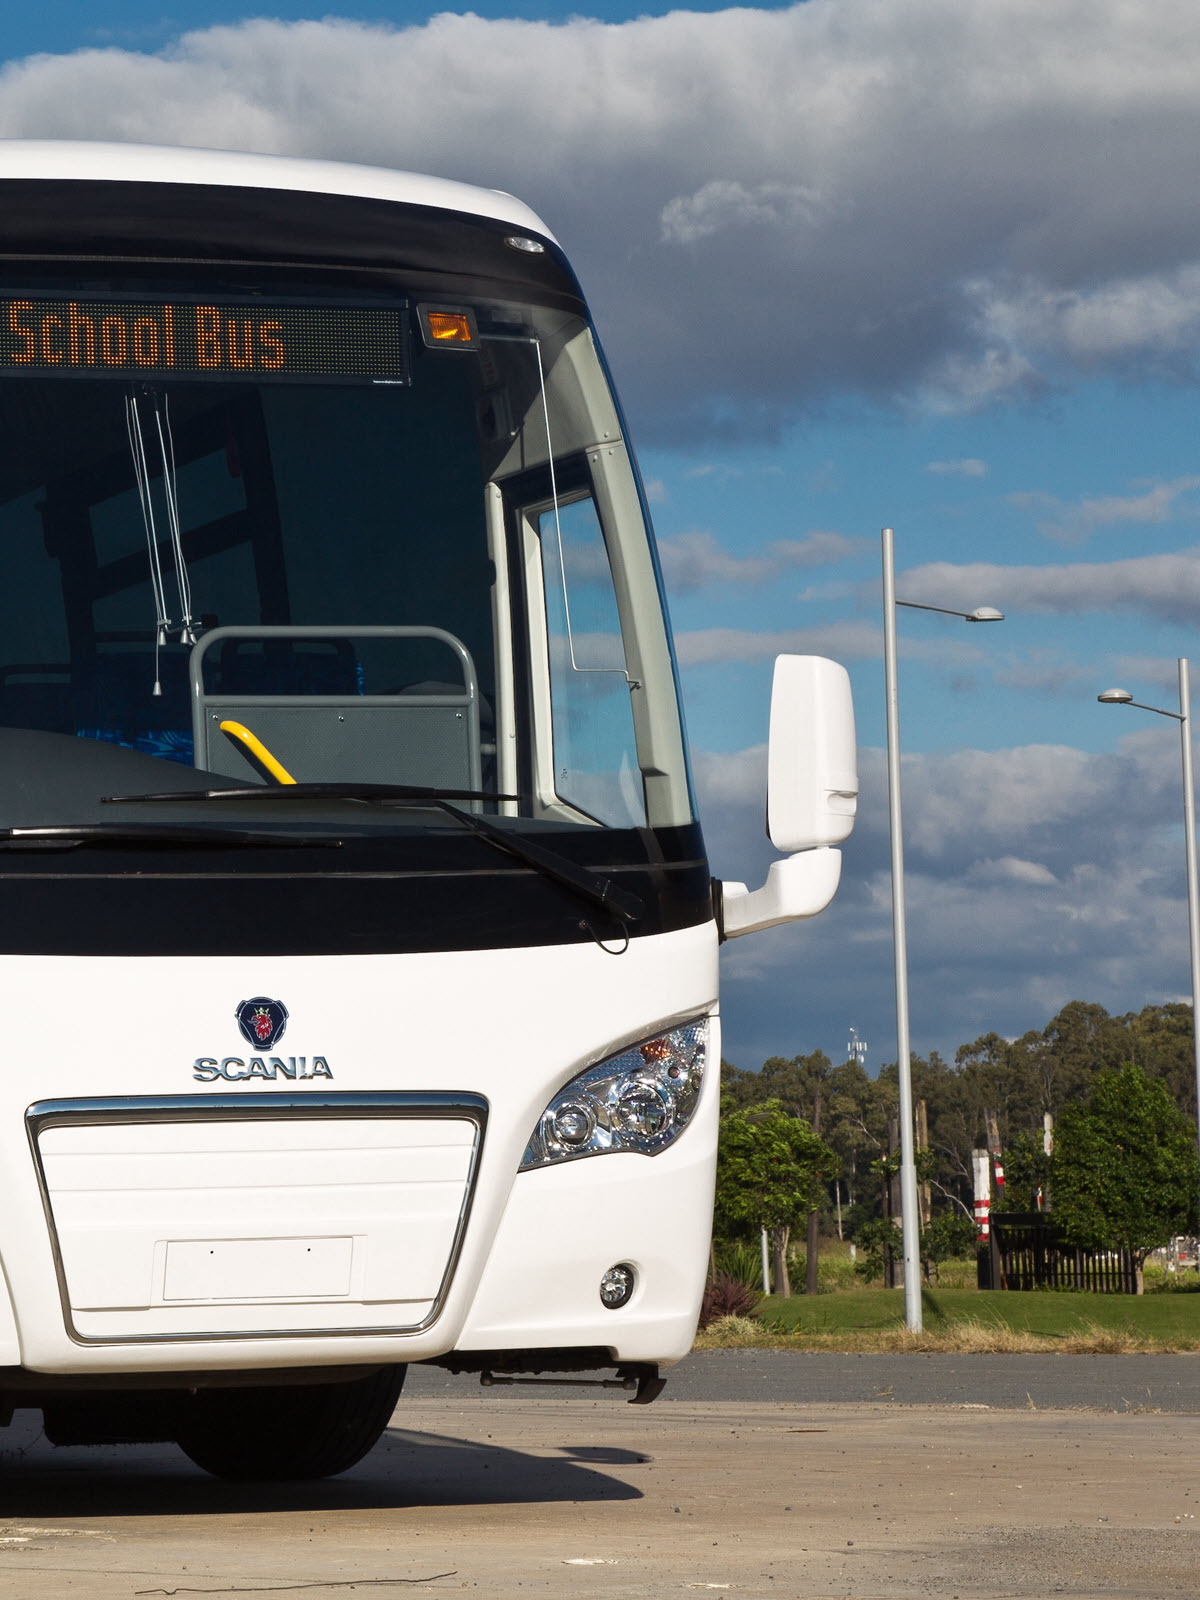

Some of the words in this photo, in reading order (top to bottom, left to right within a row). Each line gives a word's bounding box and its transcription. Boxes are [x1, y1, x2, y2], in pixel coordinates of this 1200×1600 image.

[9, 301, 175, 366] School
[196, 306, 285, 369] Bus
[192, 1056, 334, 1082] SCANIA
